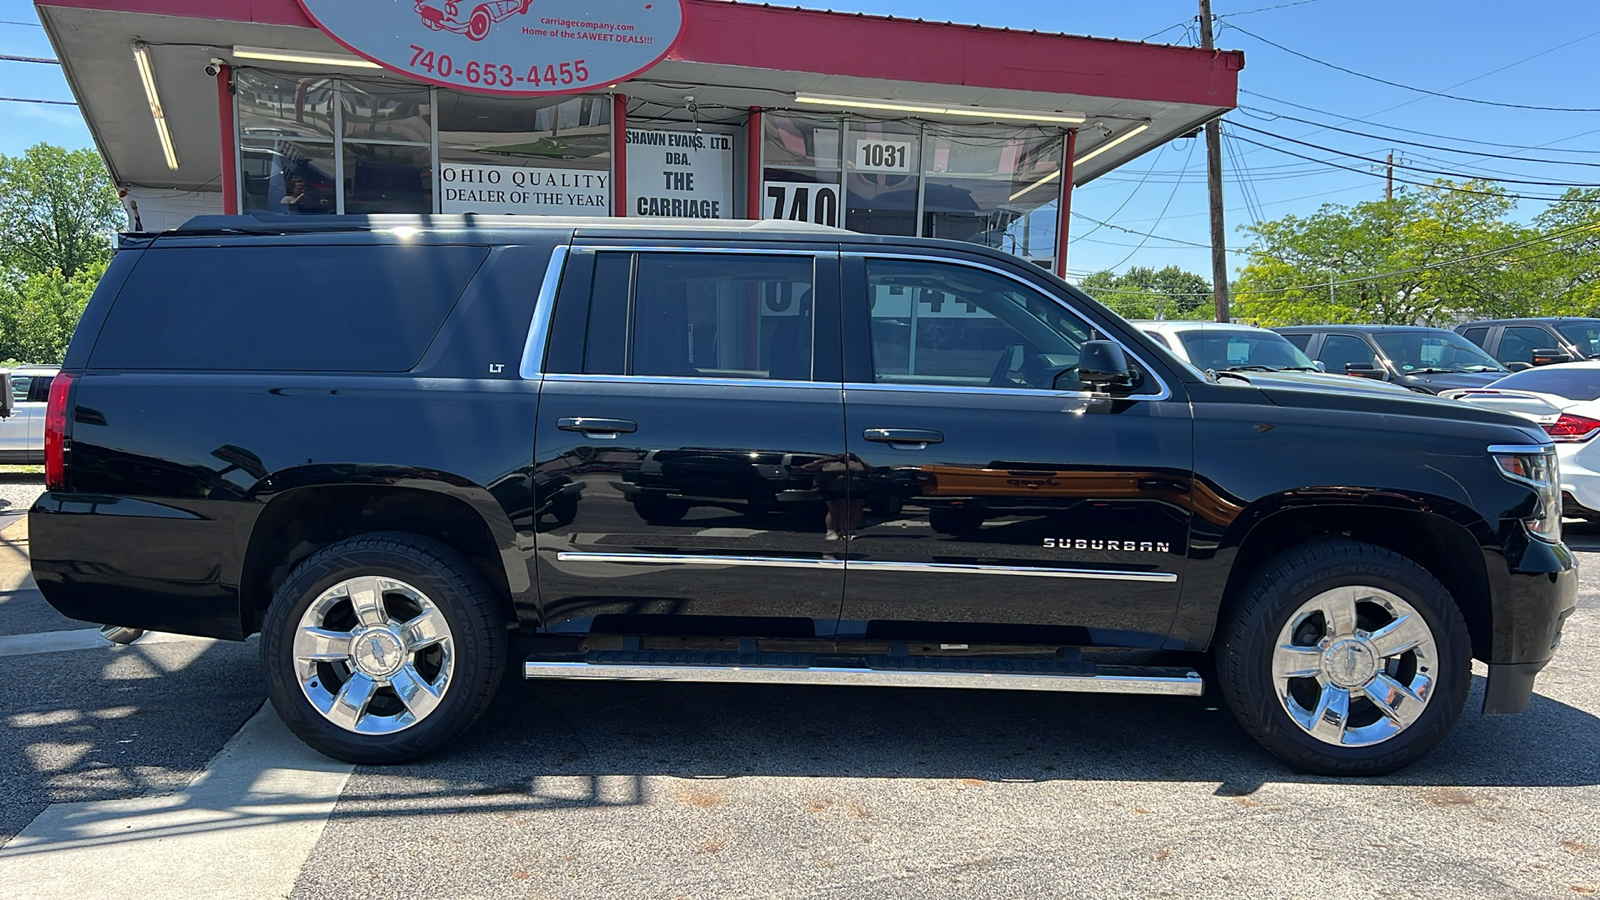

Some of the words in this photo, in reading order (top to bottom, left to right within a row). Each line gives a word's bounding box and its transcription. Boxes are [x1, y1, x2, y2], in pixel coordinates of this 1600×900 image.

[540, 17, 635, 32] carriagecompany.com
[522, 26, 548, 36] Home
[549, 29, 559, 38] of
[560, 31, 575, 39] the
[576, 31, 614, 42] SAWEET
[615, 34, 653, 45] DEALS!!!
[409, 44, 589, 87] 740-653-4455
[625, 130, 666, 146] SHAWN
[710, 136, 731, 150] LTD.
[665, 152, 691, 166] DBA.
[862, 144, 906, 168] 1031
[442, 167, 501, 184] OHIO
[512, 171, 608, 189] QUALITY
[663, 171, 694, 191] THE
[445, 188, 506, 203] DEALER
[509, 191, 530, 203] OF
[533, 192, 563, 205] THE
[567, 193, 605, 207] YEAR
[637, 196, 720, 219] CARRIAGE
[767, 186, 837, 228] 740
[489, 363, 505, 373] LT
[1043, 538, 1169, 552] SUBURBAN
[1291, 563, 1398, 595] ENDEAVOR
[1302, 748, 1409, 770] COOPER
